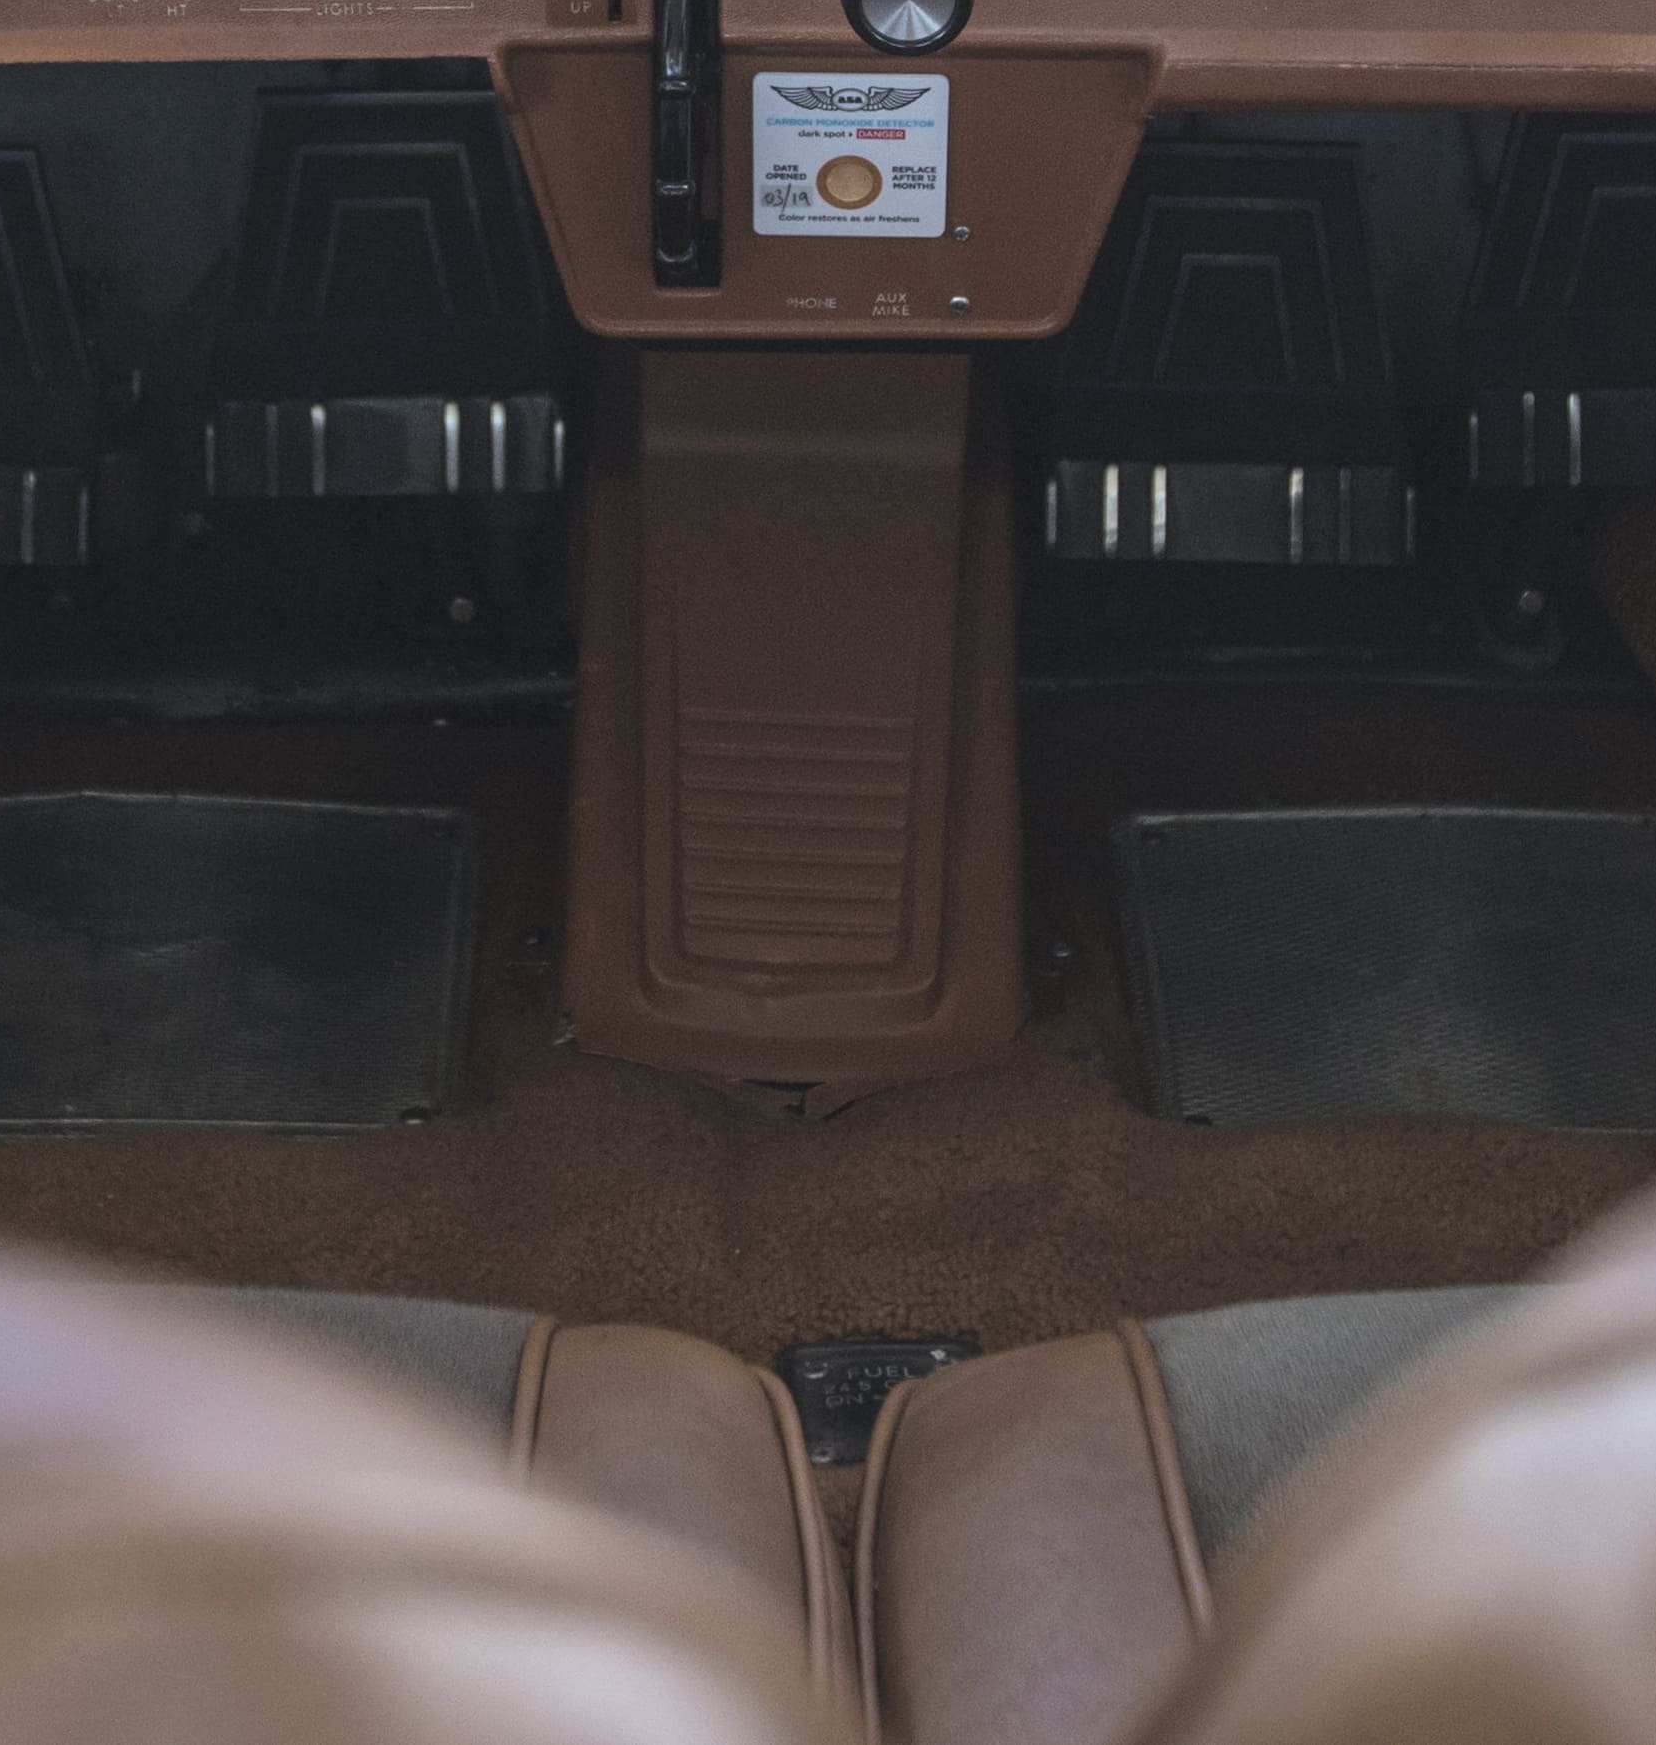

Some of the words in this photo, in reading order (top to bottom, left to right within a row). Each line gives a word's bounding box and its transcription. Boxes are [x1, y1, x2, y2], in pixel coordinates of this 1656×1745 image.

[767, 118, 813, 126] CARBON
[816, 118, 874, 127] MONOXIDE
[877, 119, 935, 127] DETECTOR
[798, 130, 821, 138] dark
[823, 131, 846, 139] spot
[766, 173, 807, 181] OPENED
[763, 183, 811, 213] 03/19
[787, 297, 837, 310] PHONE
[875, 293, 908, 304] AUX
[872, 304, 911, 316] MIKE
